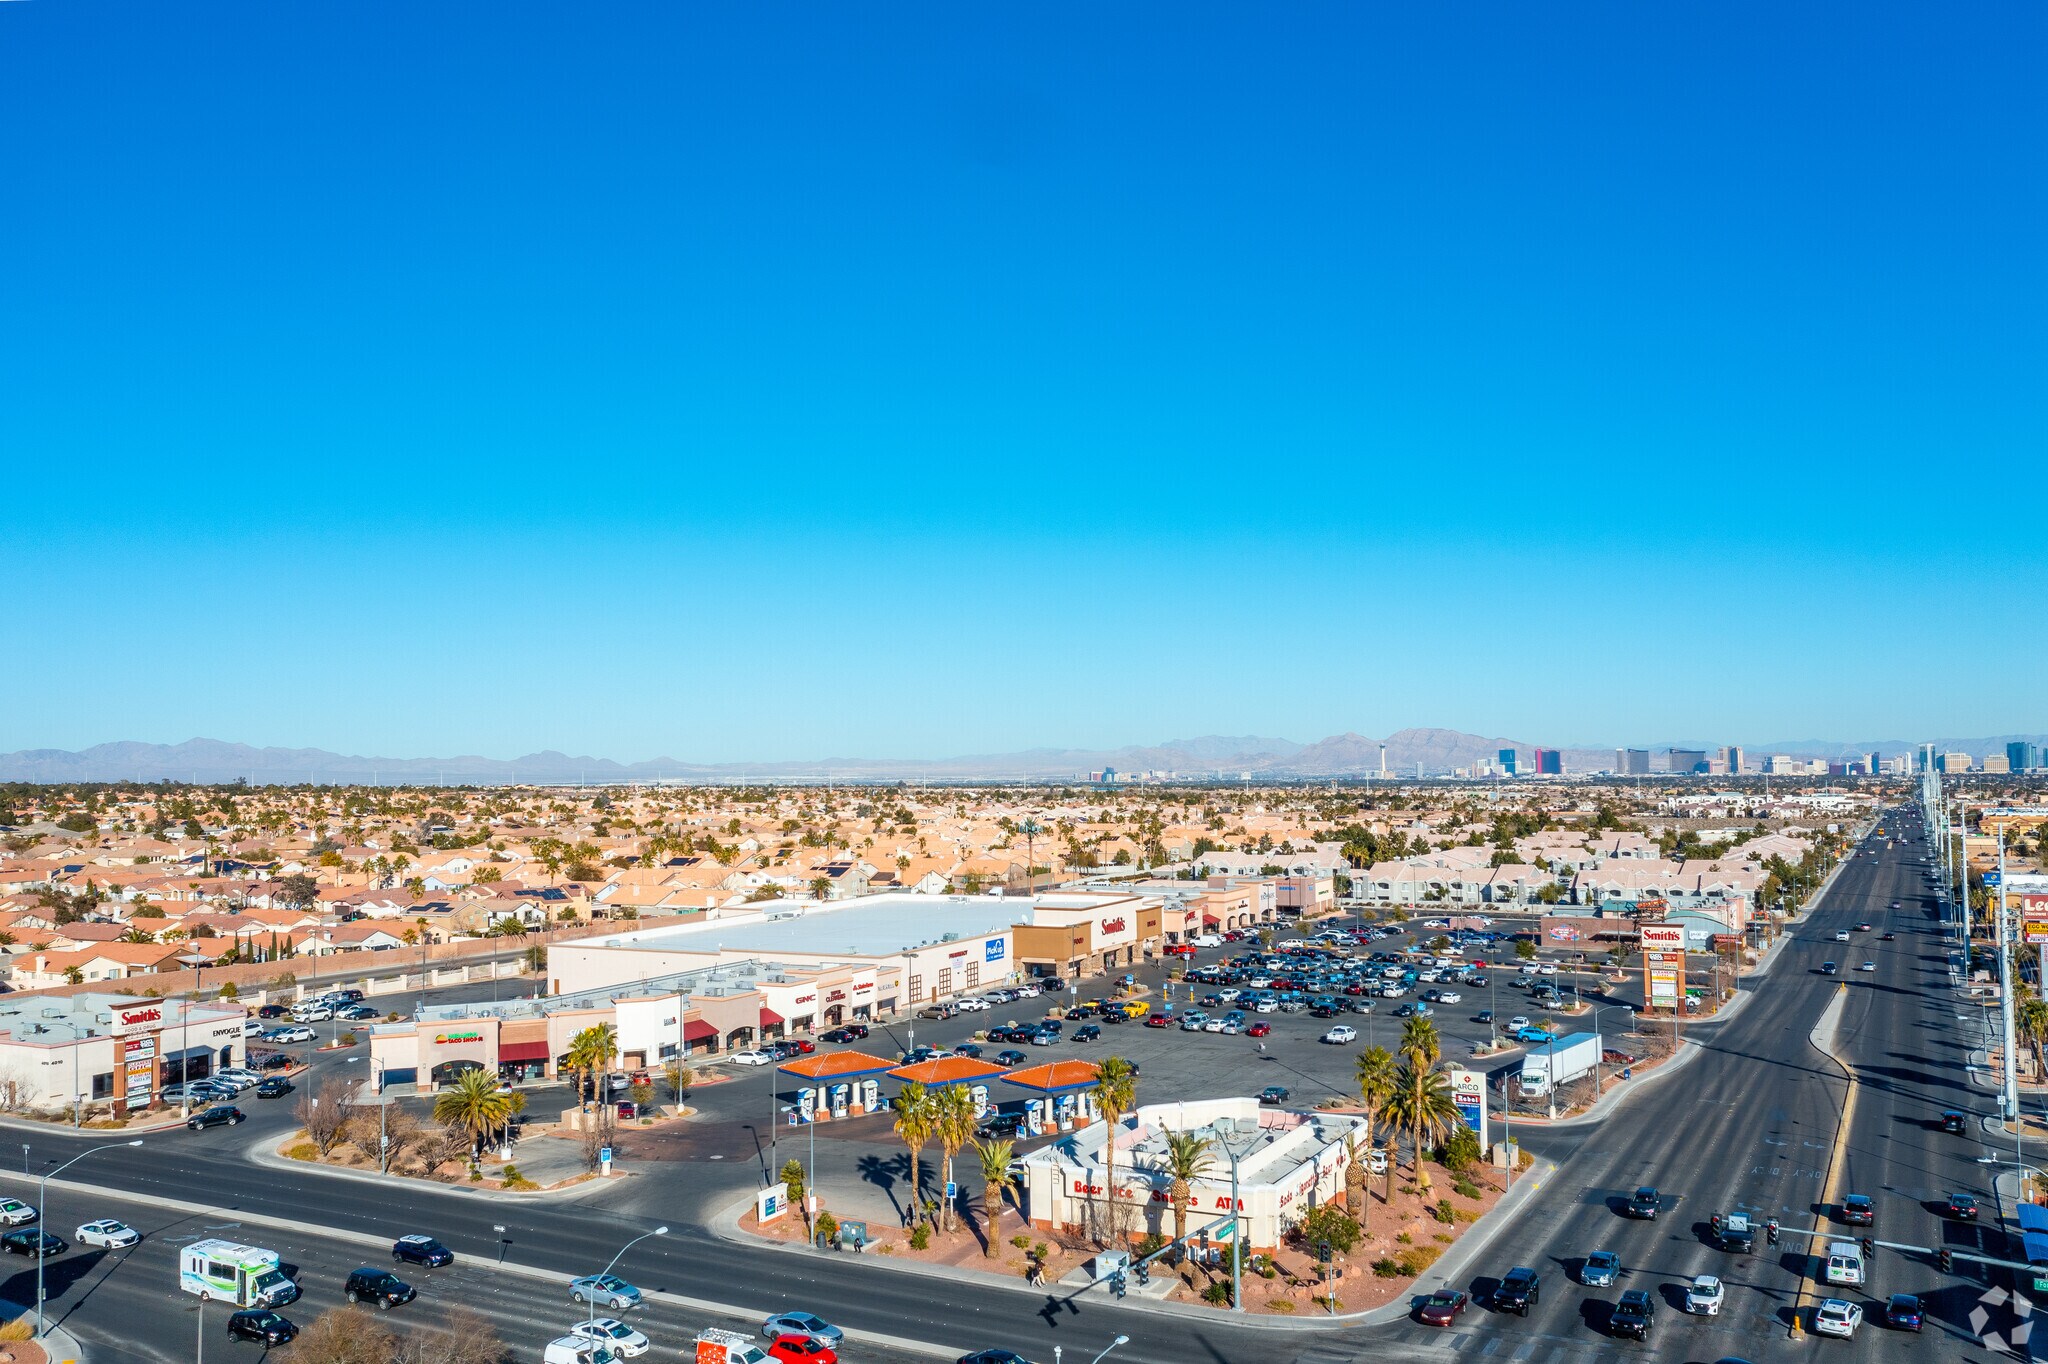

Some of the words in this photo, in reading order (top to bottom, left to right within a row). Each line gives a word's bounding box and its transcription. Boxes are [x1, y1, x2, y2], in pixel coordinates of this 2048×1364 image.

[1101, 917, 1126, 935] Smith's
[1644, 930, 1680, 941] Smith's
[795, 993, 816, 1005] GNC
[121, 1008, 161, 1026] Smith's
[212, 1026, 241, 1037] ENVOGUE
[1457, 1083, 1479, 1091] ARCO
[1457, 1094, 1479, 1103] Rebel
[1074, 1180, 1103, 1195] Beer
[1113, 1184, 1134, 1199] Ice
[1215, 1196, 1244, 1212] ATM
